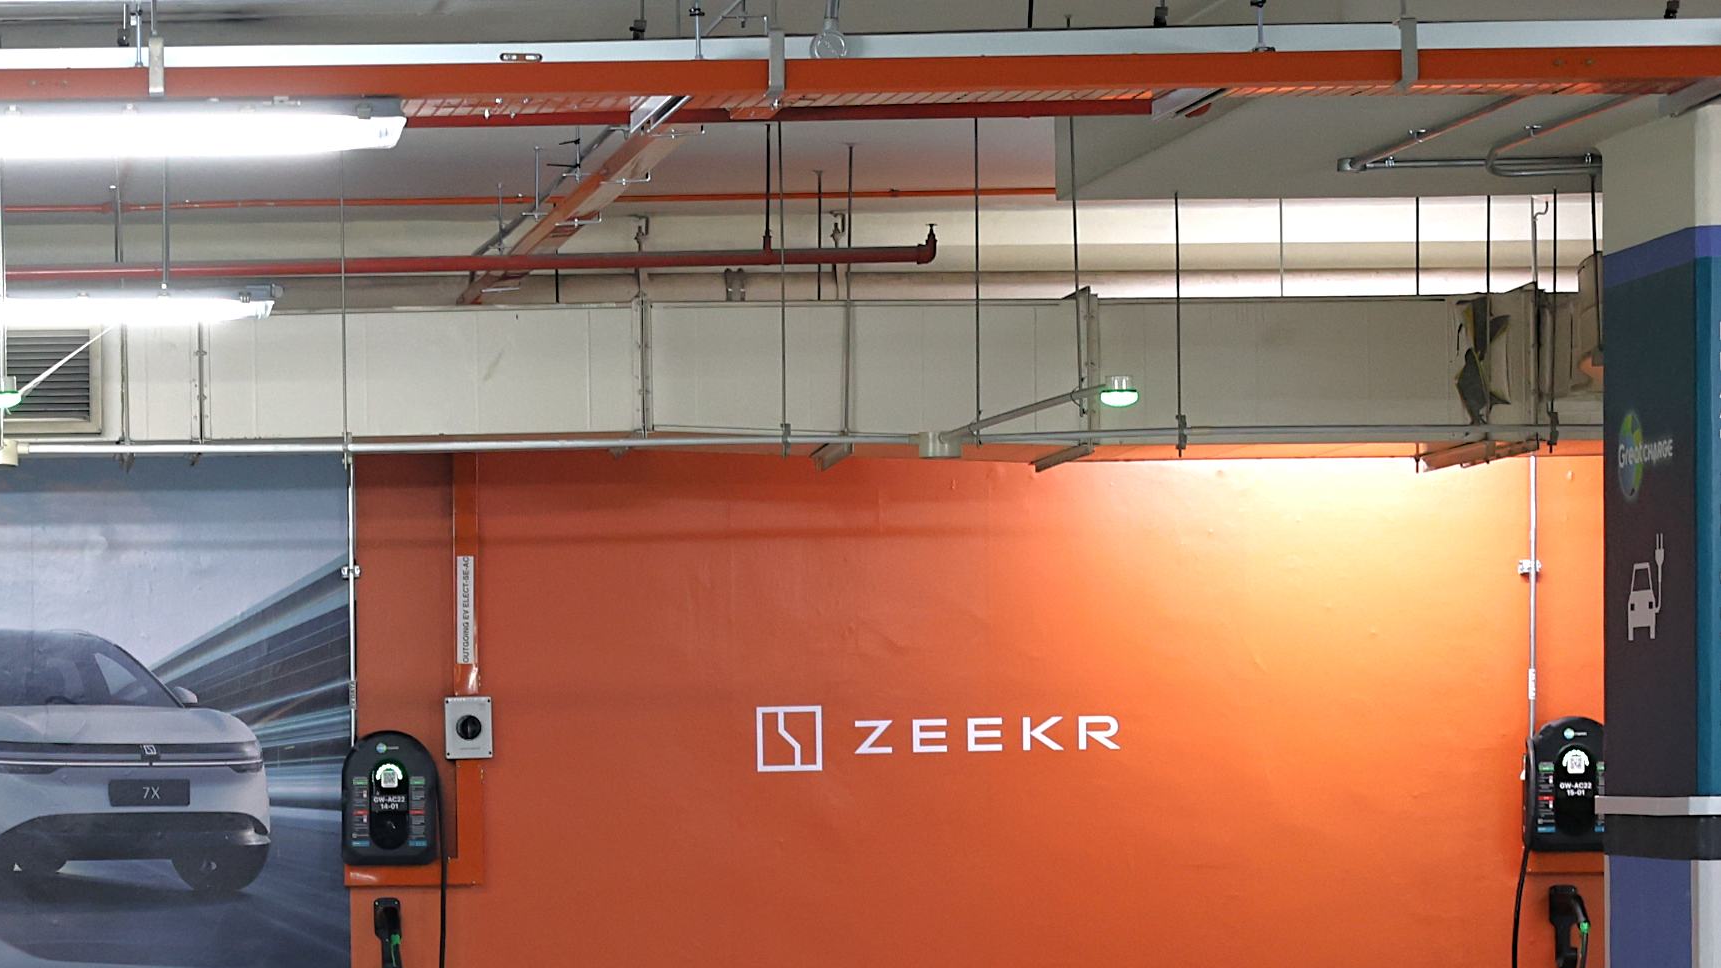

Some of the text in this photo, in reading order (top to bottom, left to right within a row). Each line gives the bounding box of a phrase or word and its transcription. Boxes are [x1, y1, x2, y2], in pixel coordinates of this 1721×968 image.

[462, 610, 469, 620] EV
[854, 715, 1121, 754] ZEEKR
[142, 786, 160, 800] 7X
